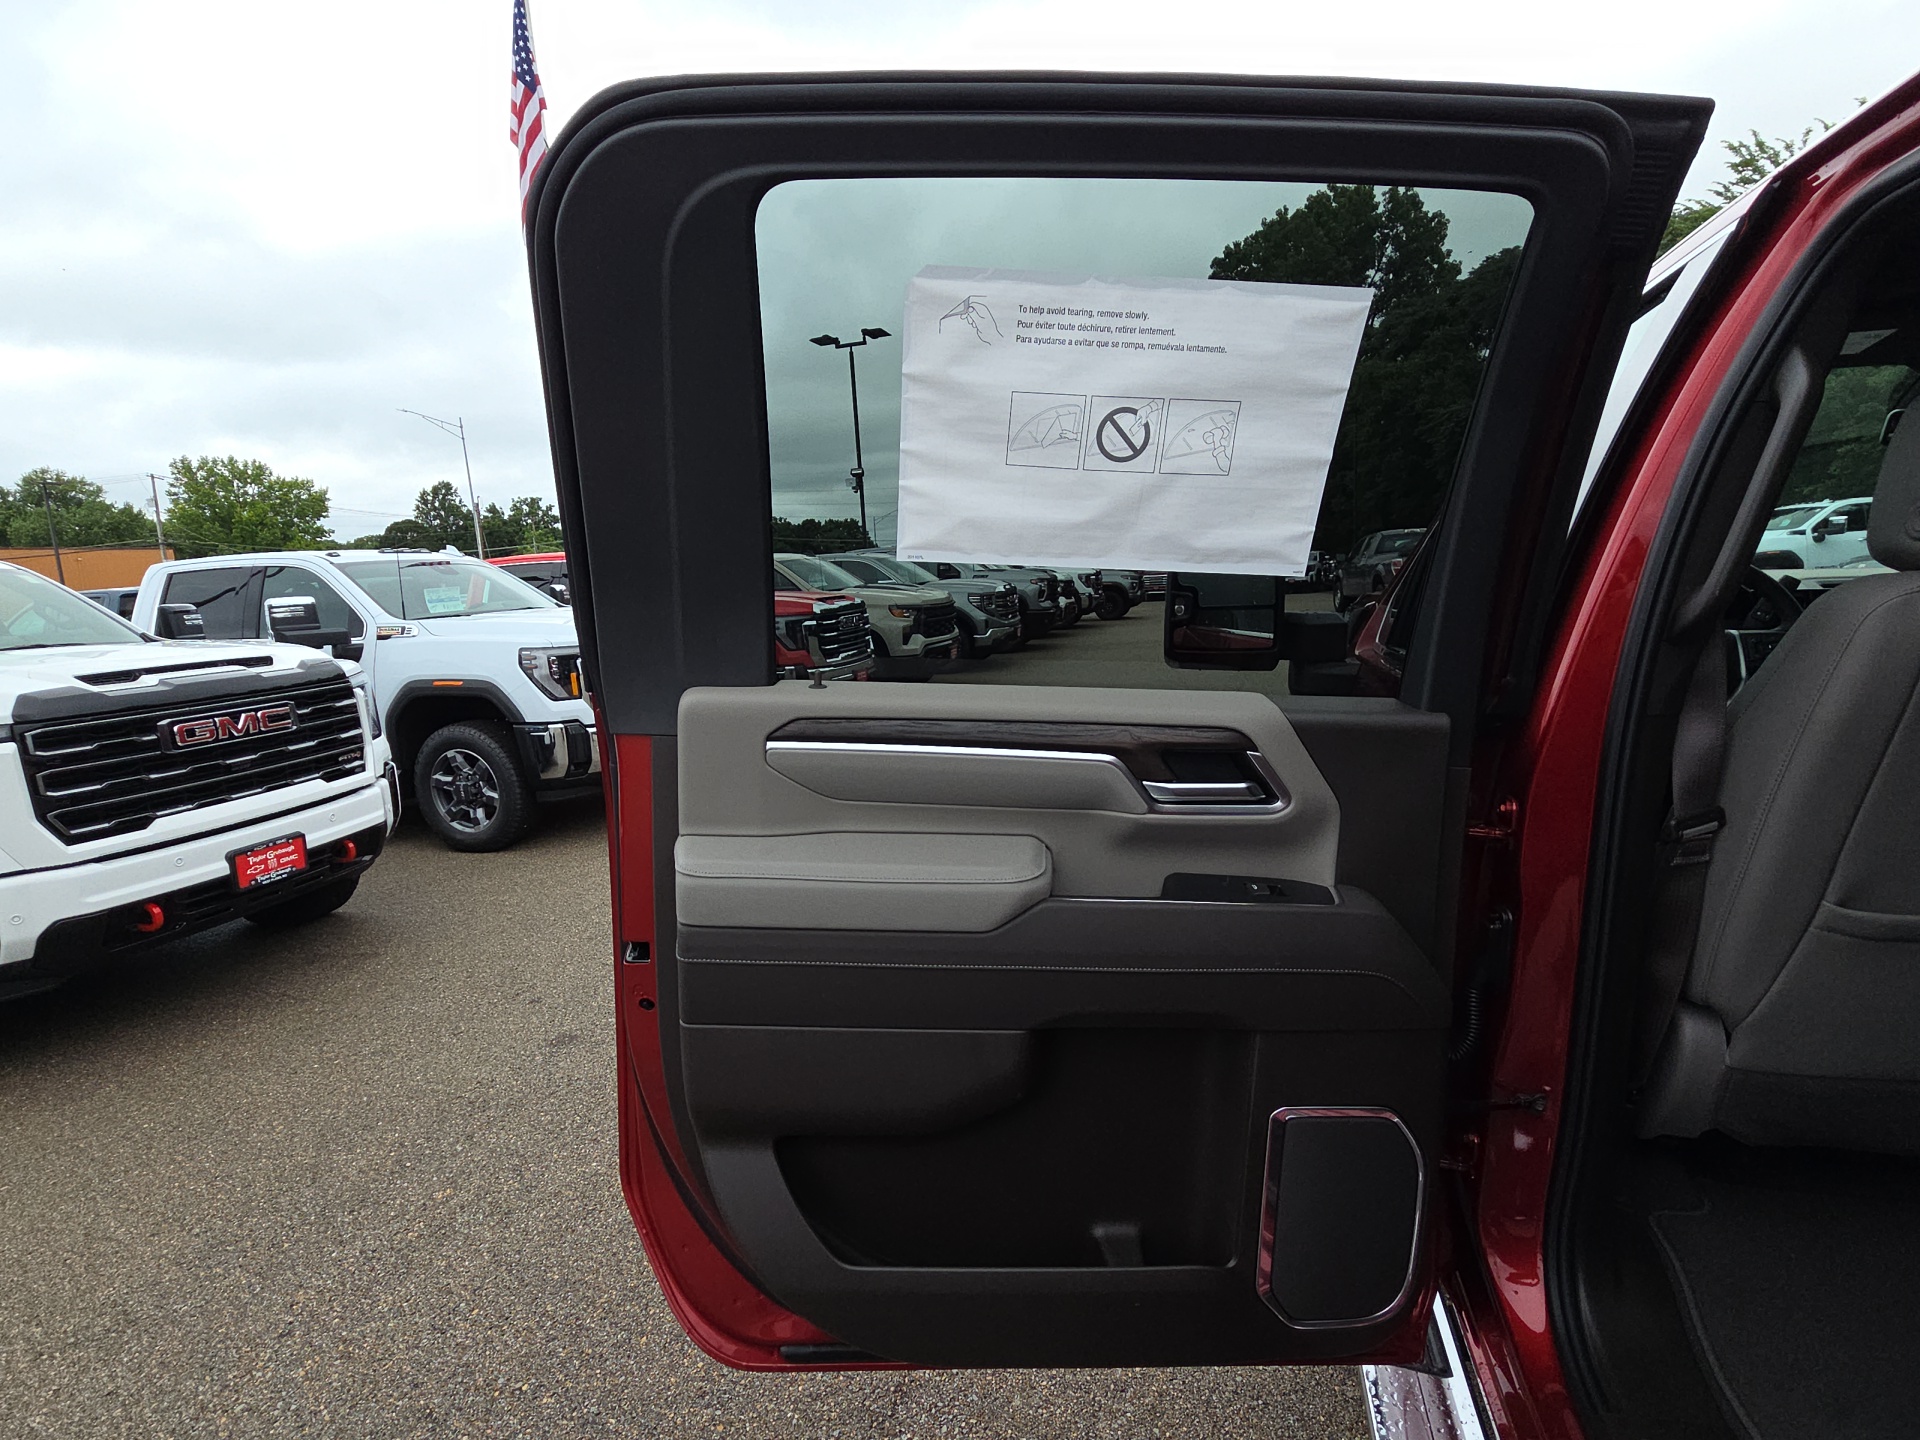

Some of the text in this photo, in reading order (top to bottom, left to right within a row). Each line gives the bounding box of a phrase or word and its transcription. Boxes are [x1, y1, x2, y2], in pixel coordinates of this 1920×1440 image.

[1018, 304, 1150, 321] To help avoid tearing, remove slowly.
[1016, 319, 1176, 336] Pour éviter toute déchirure, retirer lentement.
[1015, 334, 1032, 343] Para
[1033, 336, 1066, 345] ayudarse
[1067, 338, 1073, 346] a
[1074, 338, 1094, 347] evitar
[1095, 340, 1109, 349] que
[1121, 341, 1146, 351] rompa,
[1147, 341, 1185, 351] remuévala
[1186, 343, 1227, 354] lentamente.
[173, 706, 293, 747] GMC
[247, 854, 266, 865] Taylor
[279, 853, 299, 864] GMC
